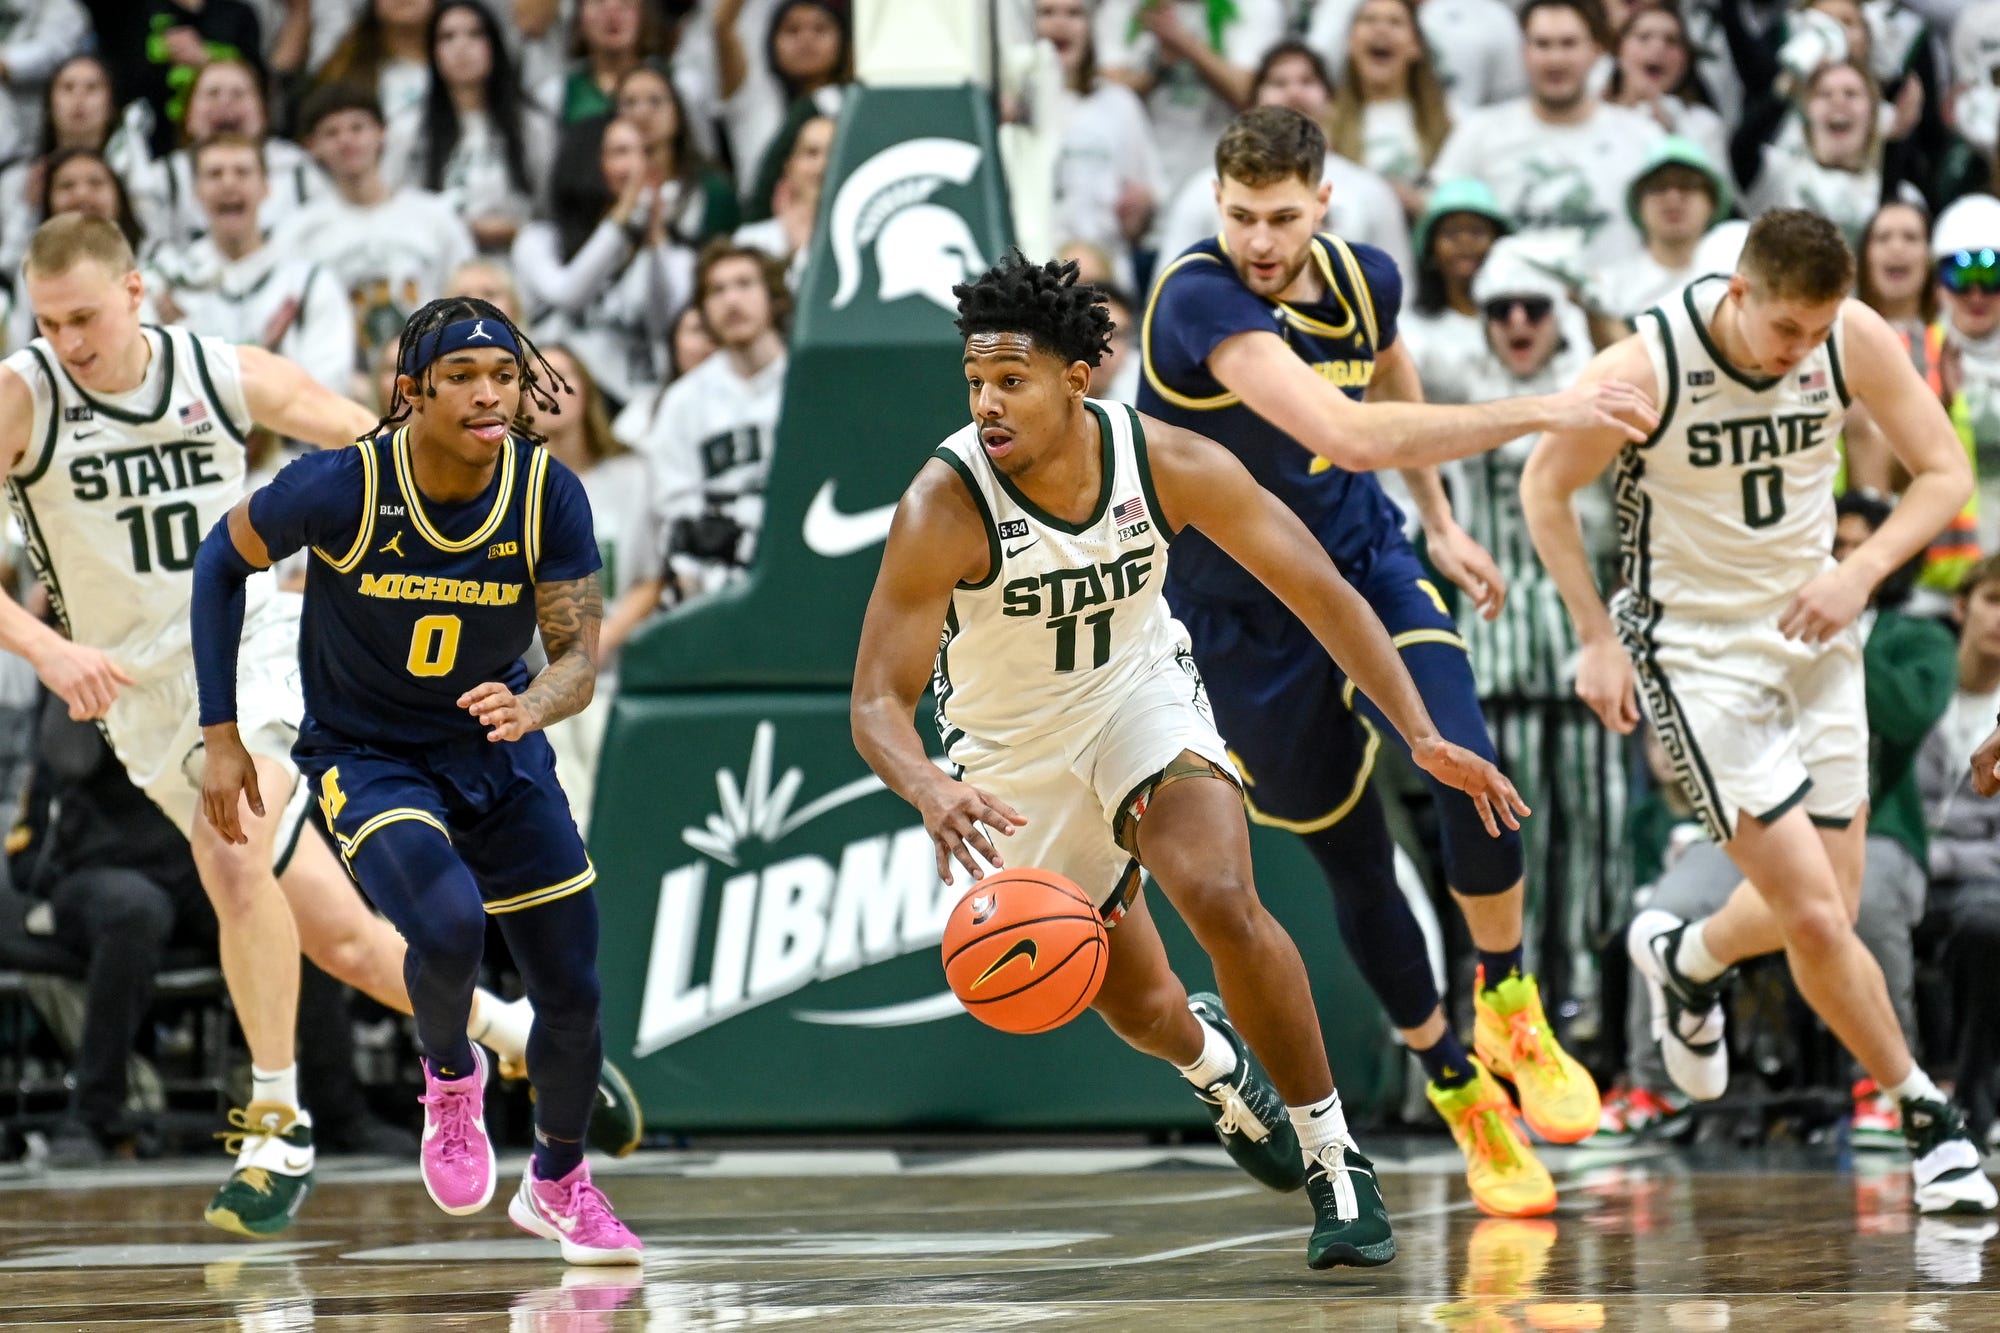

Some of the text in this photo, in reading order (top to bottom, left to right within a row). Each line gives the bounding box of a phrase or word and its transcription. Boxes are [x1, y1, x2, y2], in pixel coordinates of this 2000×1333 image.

[69, 441, 223, 500] STATE
[1687, 411, 1830, 468] STATE
[380, 505, 404, 516] BLM
[1742, 465, 1786, 530] 0
[116, 501, 201, 573] 10
[358, 574, 523, 606] MICHIGAN
[1003, 543, 1155, 618] STATE
[406, 614, 462, 677] 0
[1046, 608, 1115, 671] 11
